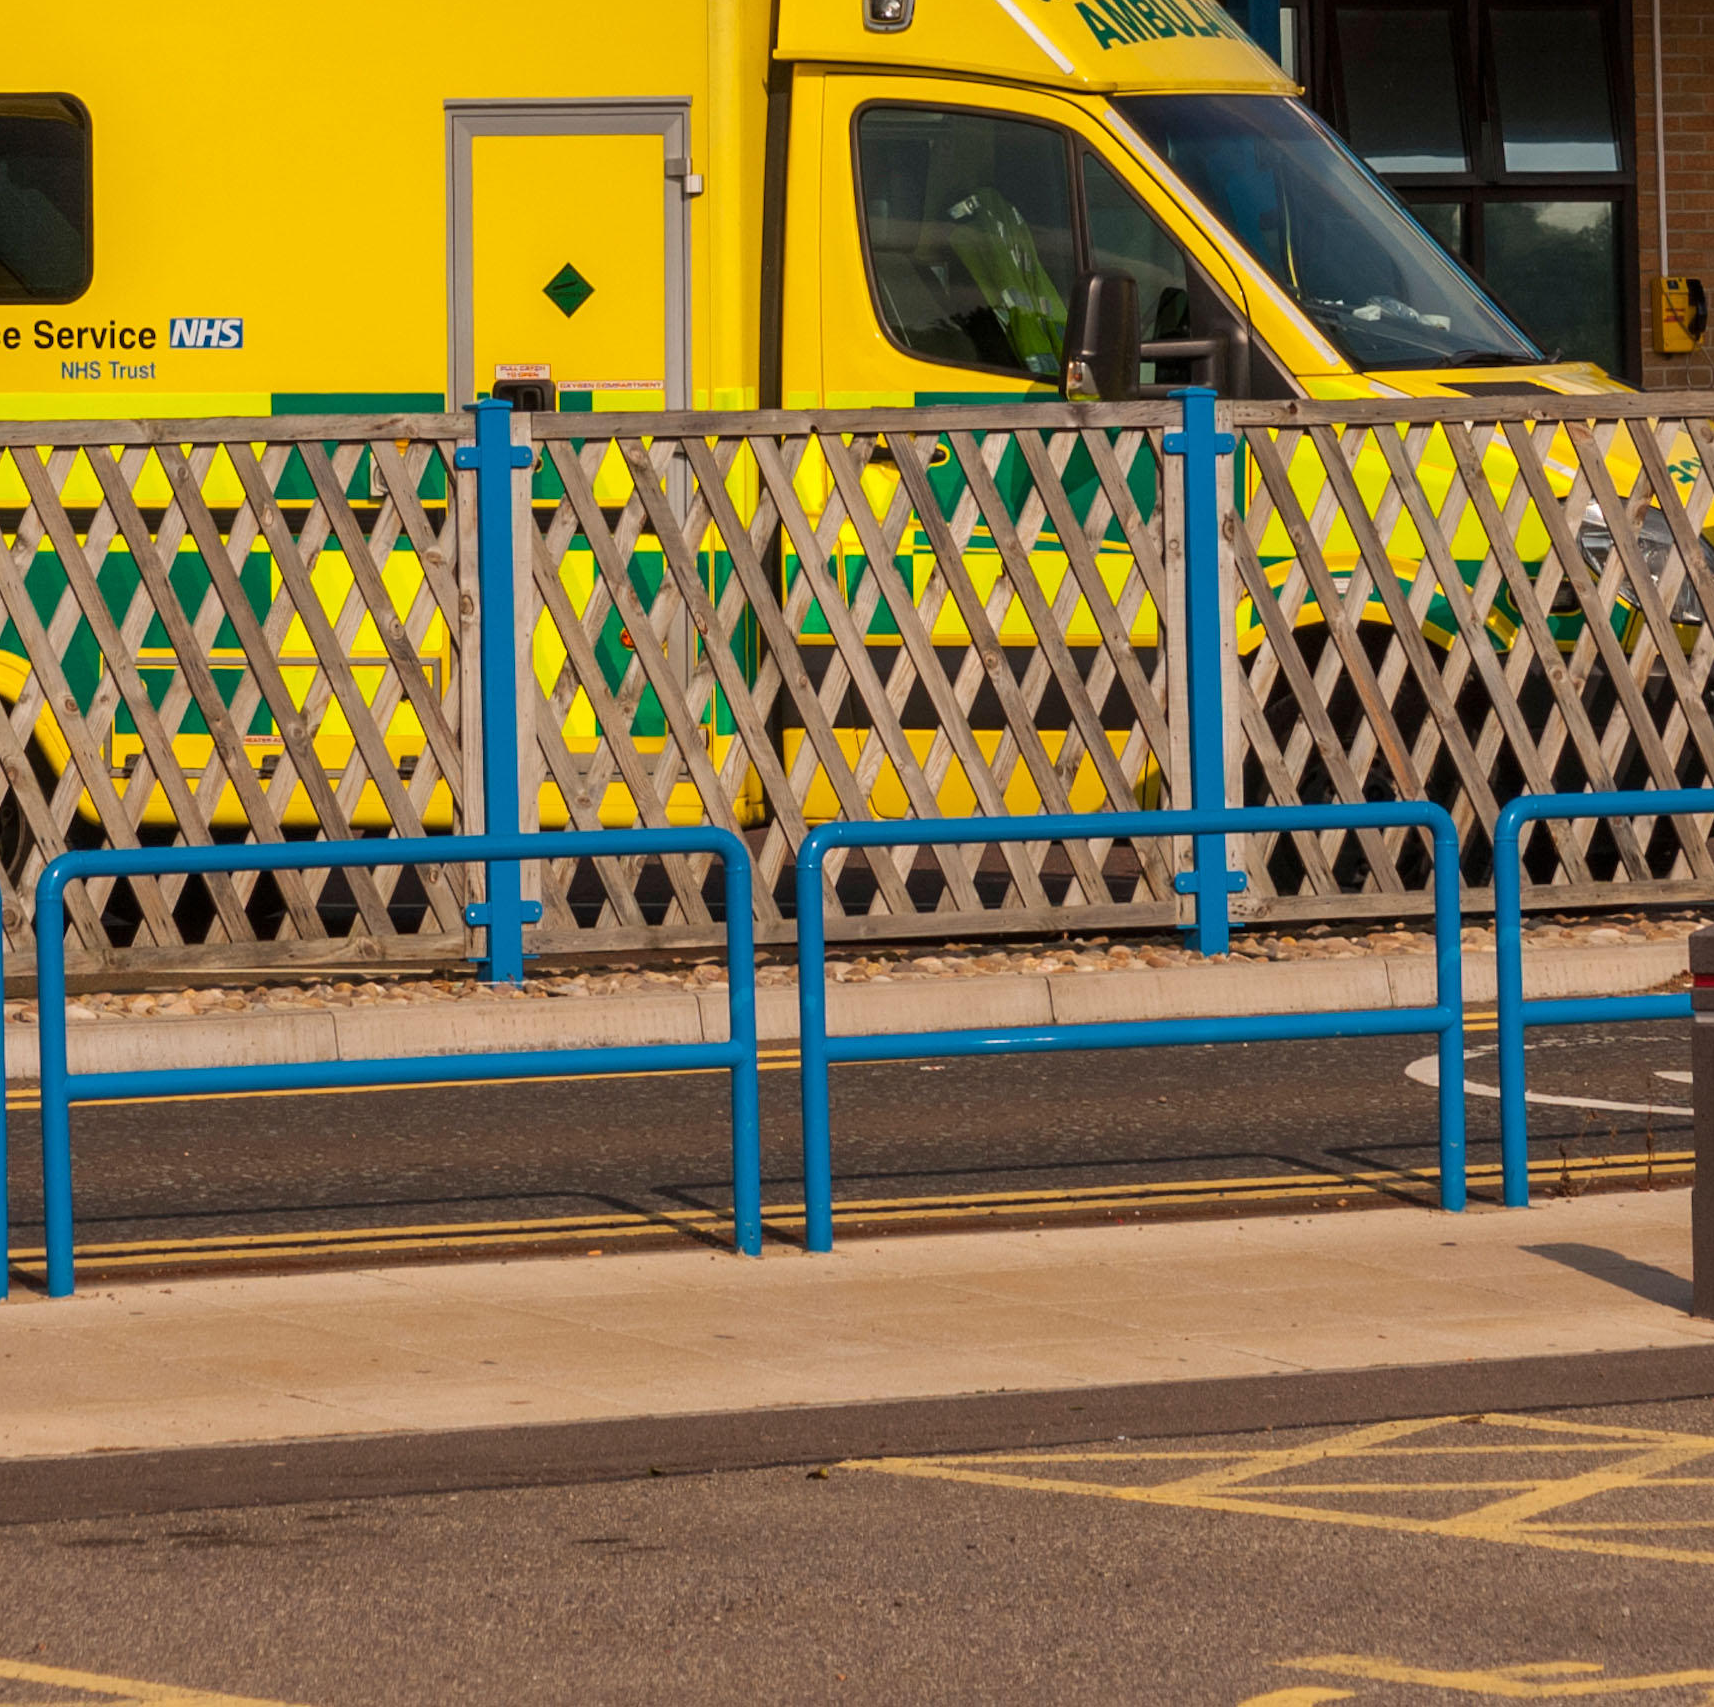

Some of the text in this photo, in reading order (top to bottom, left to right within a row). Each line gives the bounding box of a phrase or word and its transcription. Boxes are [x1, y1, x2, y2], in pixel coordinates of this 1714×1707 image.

[33, 320, 157, 350] Service
[170, 319, 240, 348] NHS
[61, 361, 156, 379] NHS Trust
